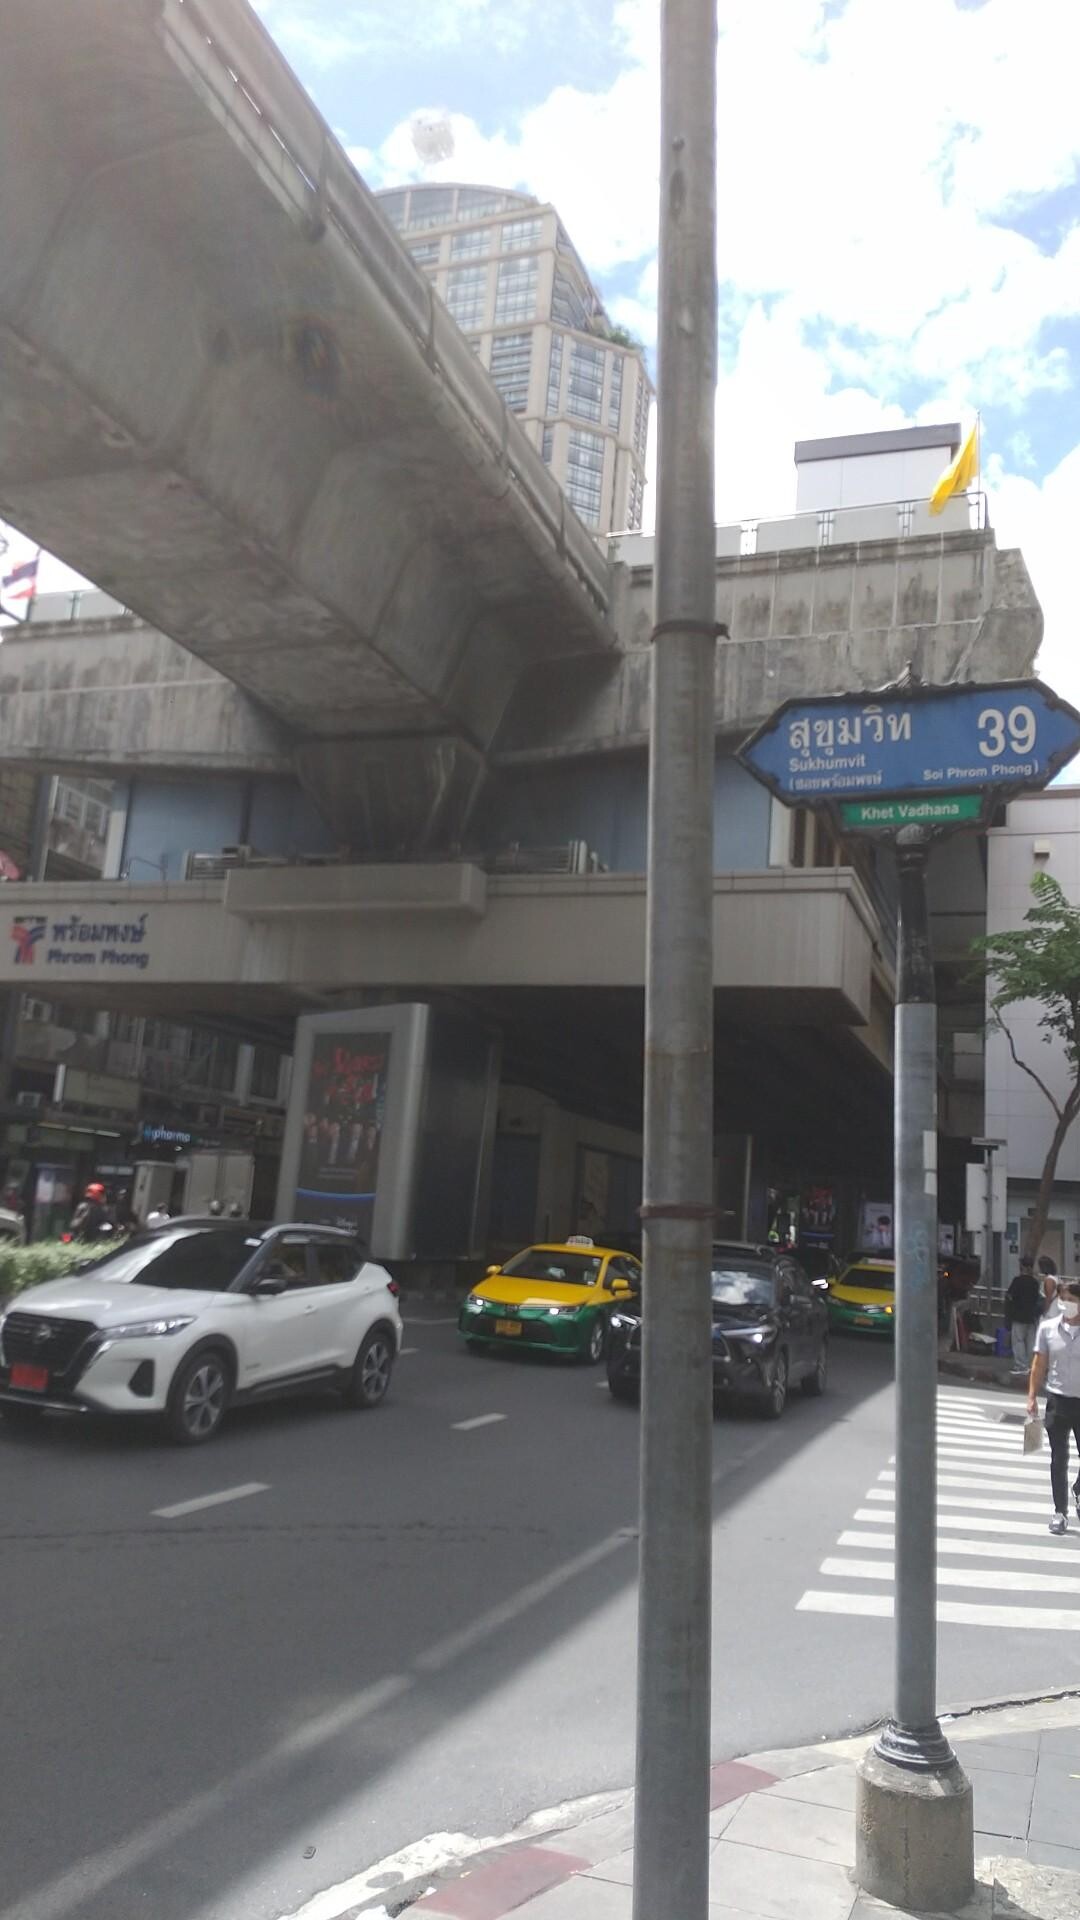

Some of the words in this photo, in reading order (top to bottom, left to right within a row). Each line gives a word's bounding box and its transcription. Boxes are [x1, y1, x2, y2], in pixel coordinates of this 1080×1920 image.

[789, 704, 911, 757] สุขุมวิท
[978, 705, 1037, 758] 39
[789, 753, 866, 773] Sukhumvit
[923, 768, 944, 781] Soi
[947, 765, 988, 779] Phrom
[861, 804, 894, 821] Khet
[898, 802, 960, 819] Vadhana
[52, 913, 149, 944] พร้อมพงษ์
[48, 949, 96, 965] Phrom
[101, 949, 149, 970] Phong
